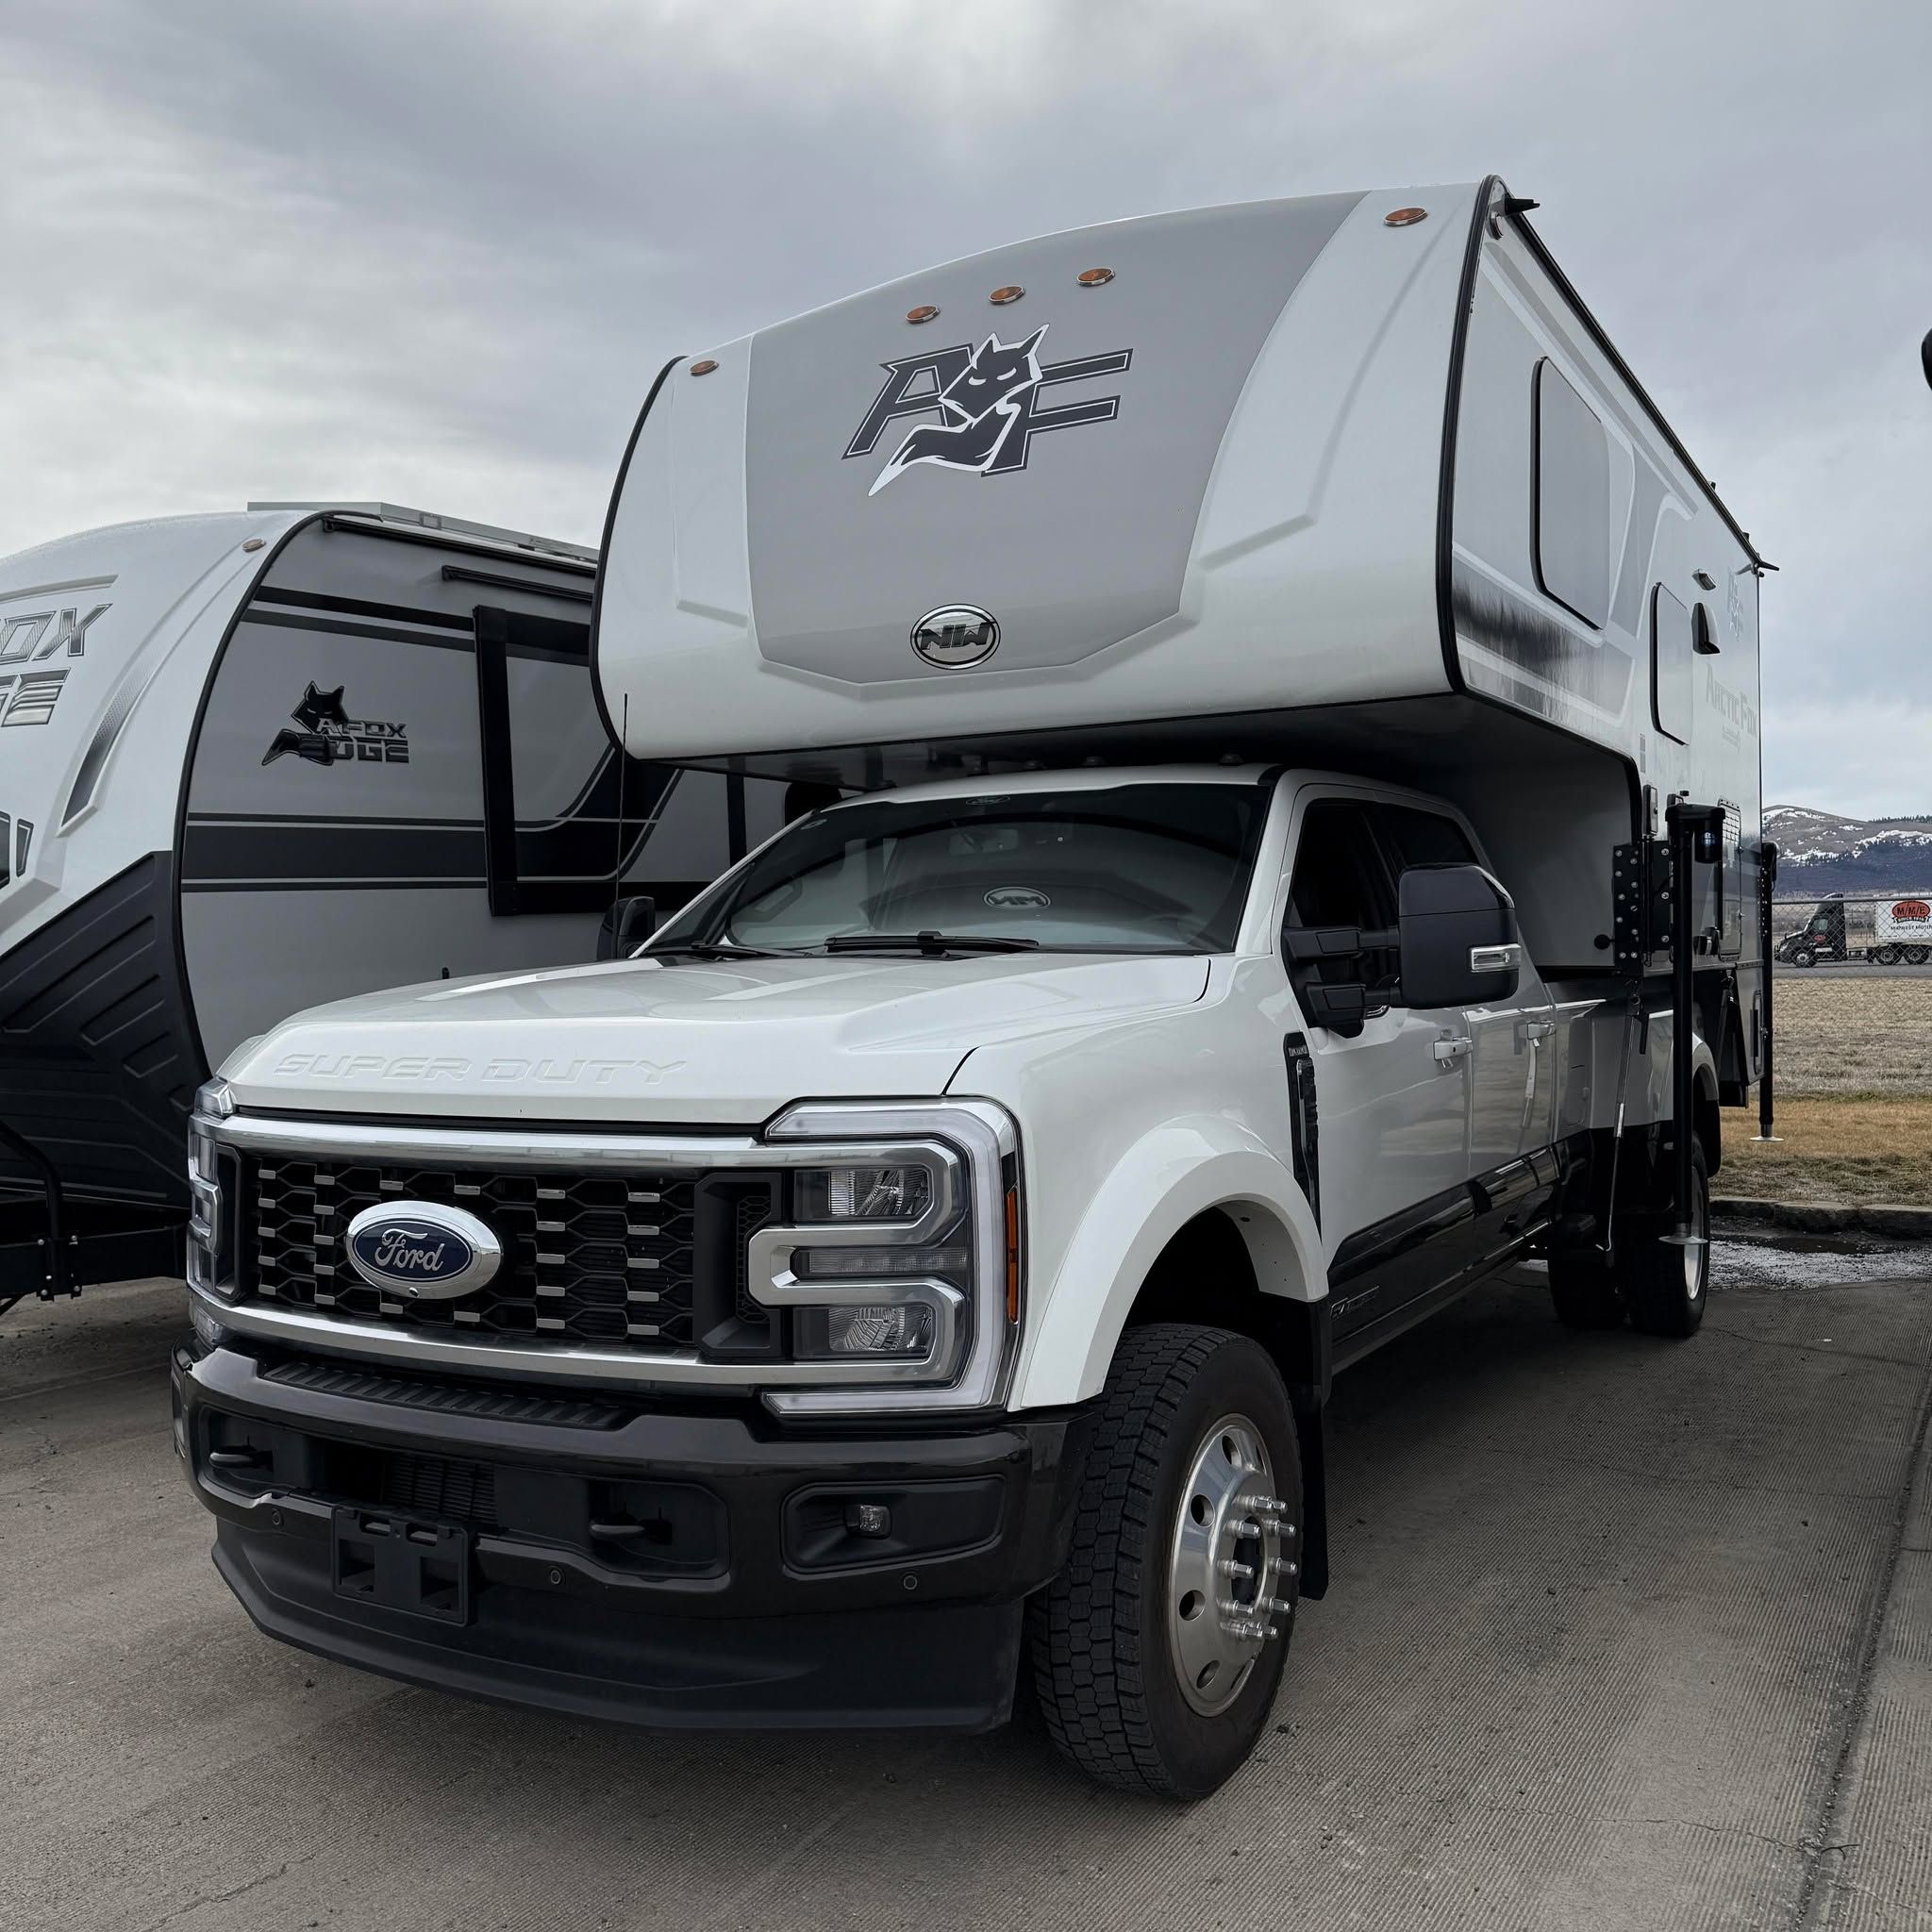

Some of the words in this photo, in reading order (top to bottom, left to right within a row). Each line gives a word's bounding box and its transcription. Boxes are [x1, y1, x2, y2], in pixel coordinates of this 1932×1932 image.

[272, 1053, 474, 1081] SUPER
[481, 1058, 688, 1085] DUTY
[375, 1228, 445, 1271] Ford
